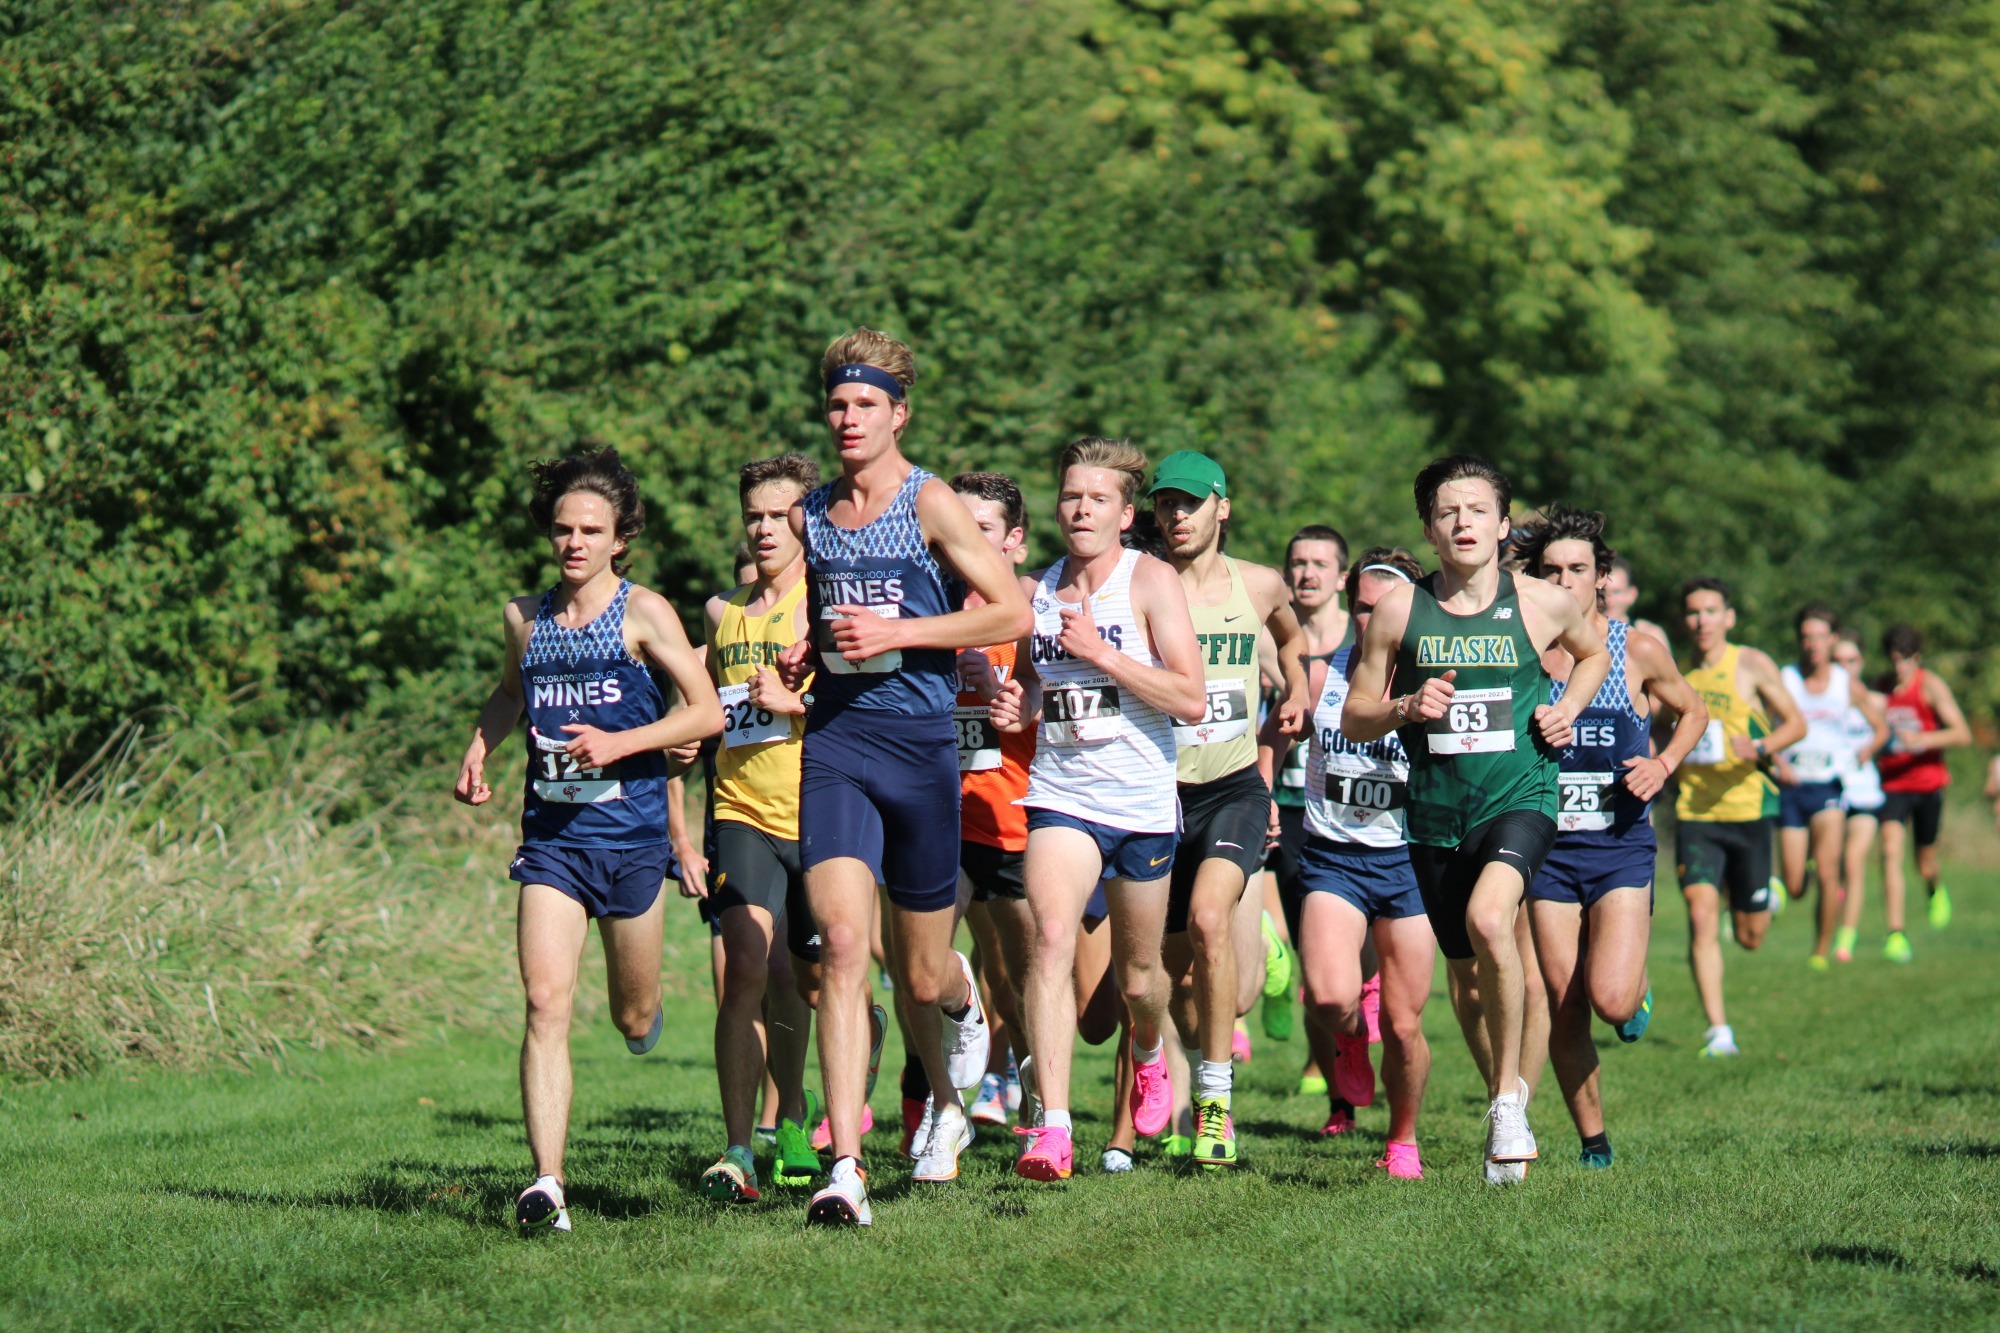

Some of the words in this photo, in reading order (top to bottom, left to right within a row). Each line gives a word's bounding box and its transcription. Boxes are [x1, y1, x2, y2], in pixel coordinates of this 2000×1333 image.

[818, 578, 904, 605] MINES
[1416, 635, 1519, 667] ALASKA
[534, 678, 622, 709] MINES
[1052, 689, 1102, 720] 107
[1450, 702, 1489, 732] 63
[1338, 778, 1392, 809] 100
[1563, 785, 1599, 811] 25
